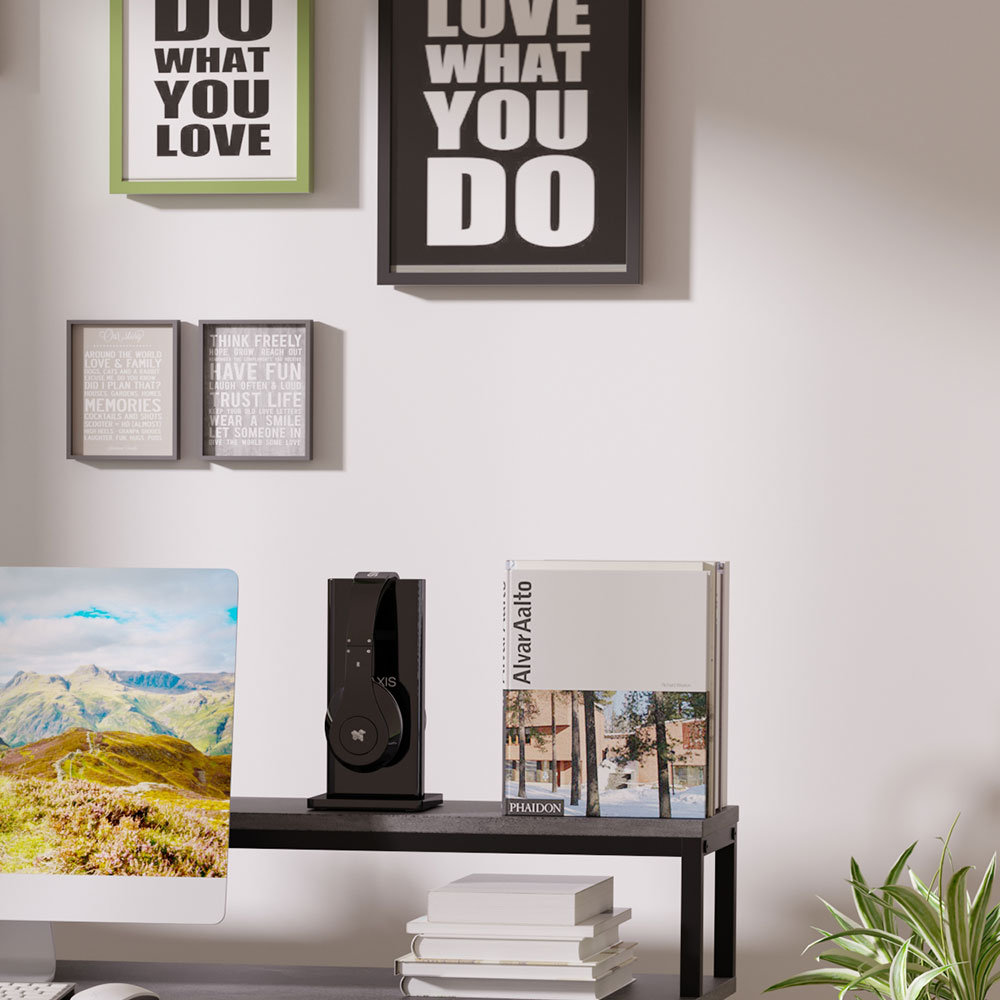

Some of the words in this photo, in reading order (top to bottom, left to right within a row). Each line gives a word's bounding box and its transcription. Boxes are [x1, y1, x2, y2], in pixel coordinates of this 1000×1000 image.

[154, 0, 272, 42] DO
[427, 0, 591, 38] LOVE
[154, 47, 270, 73] WHAT
[425, 43, 591, 84] WHAT
[154, 79, 270, 119] YOU
[423, 89, 588, 151] YOU
[155, 123, 271, 157] LOVE
[426, 154, 595, 247] DO
[209, 334, 249, 347] THINK
[255, 334, 302, 347] FREELY
[85, 359, 109, 368] LOVE
[114, 359, 122, 368] &
[127, 359, 161, 368] FAMILY
[210, 362, 257, 380] HAVE
[266, 362, 300, 380] FUN
[108, 382, 131, 390] PLAN
[209, 382, 236, 390] LAUGH
[241, 382, 268, 390] OFTEN
[281, 382, 301, 390] LOUD
[85, 398, 161, 412] MEMORIES
[210, 392, 260, 407] TRUST
[268, 392, 302, 407] LIFE
[210, 415, 242, 426] WEAR
[250, 415, 257, 426] A
[266, 415, 301, 426] SMILE
[209, 427, 229, 438] LET
[234, 427, 286, 438] SOMEONE
[290, 427, 301, 438] IN
[371, 676, 397, 687] XIS
[509, 802, 561, 813] PHAIDON
